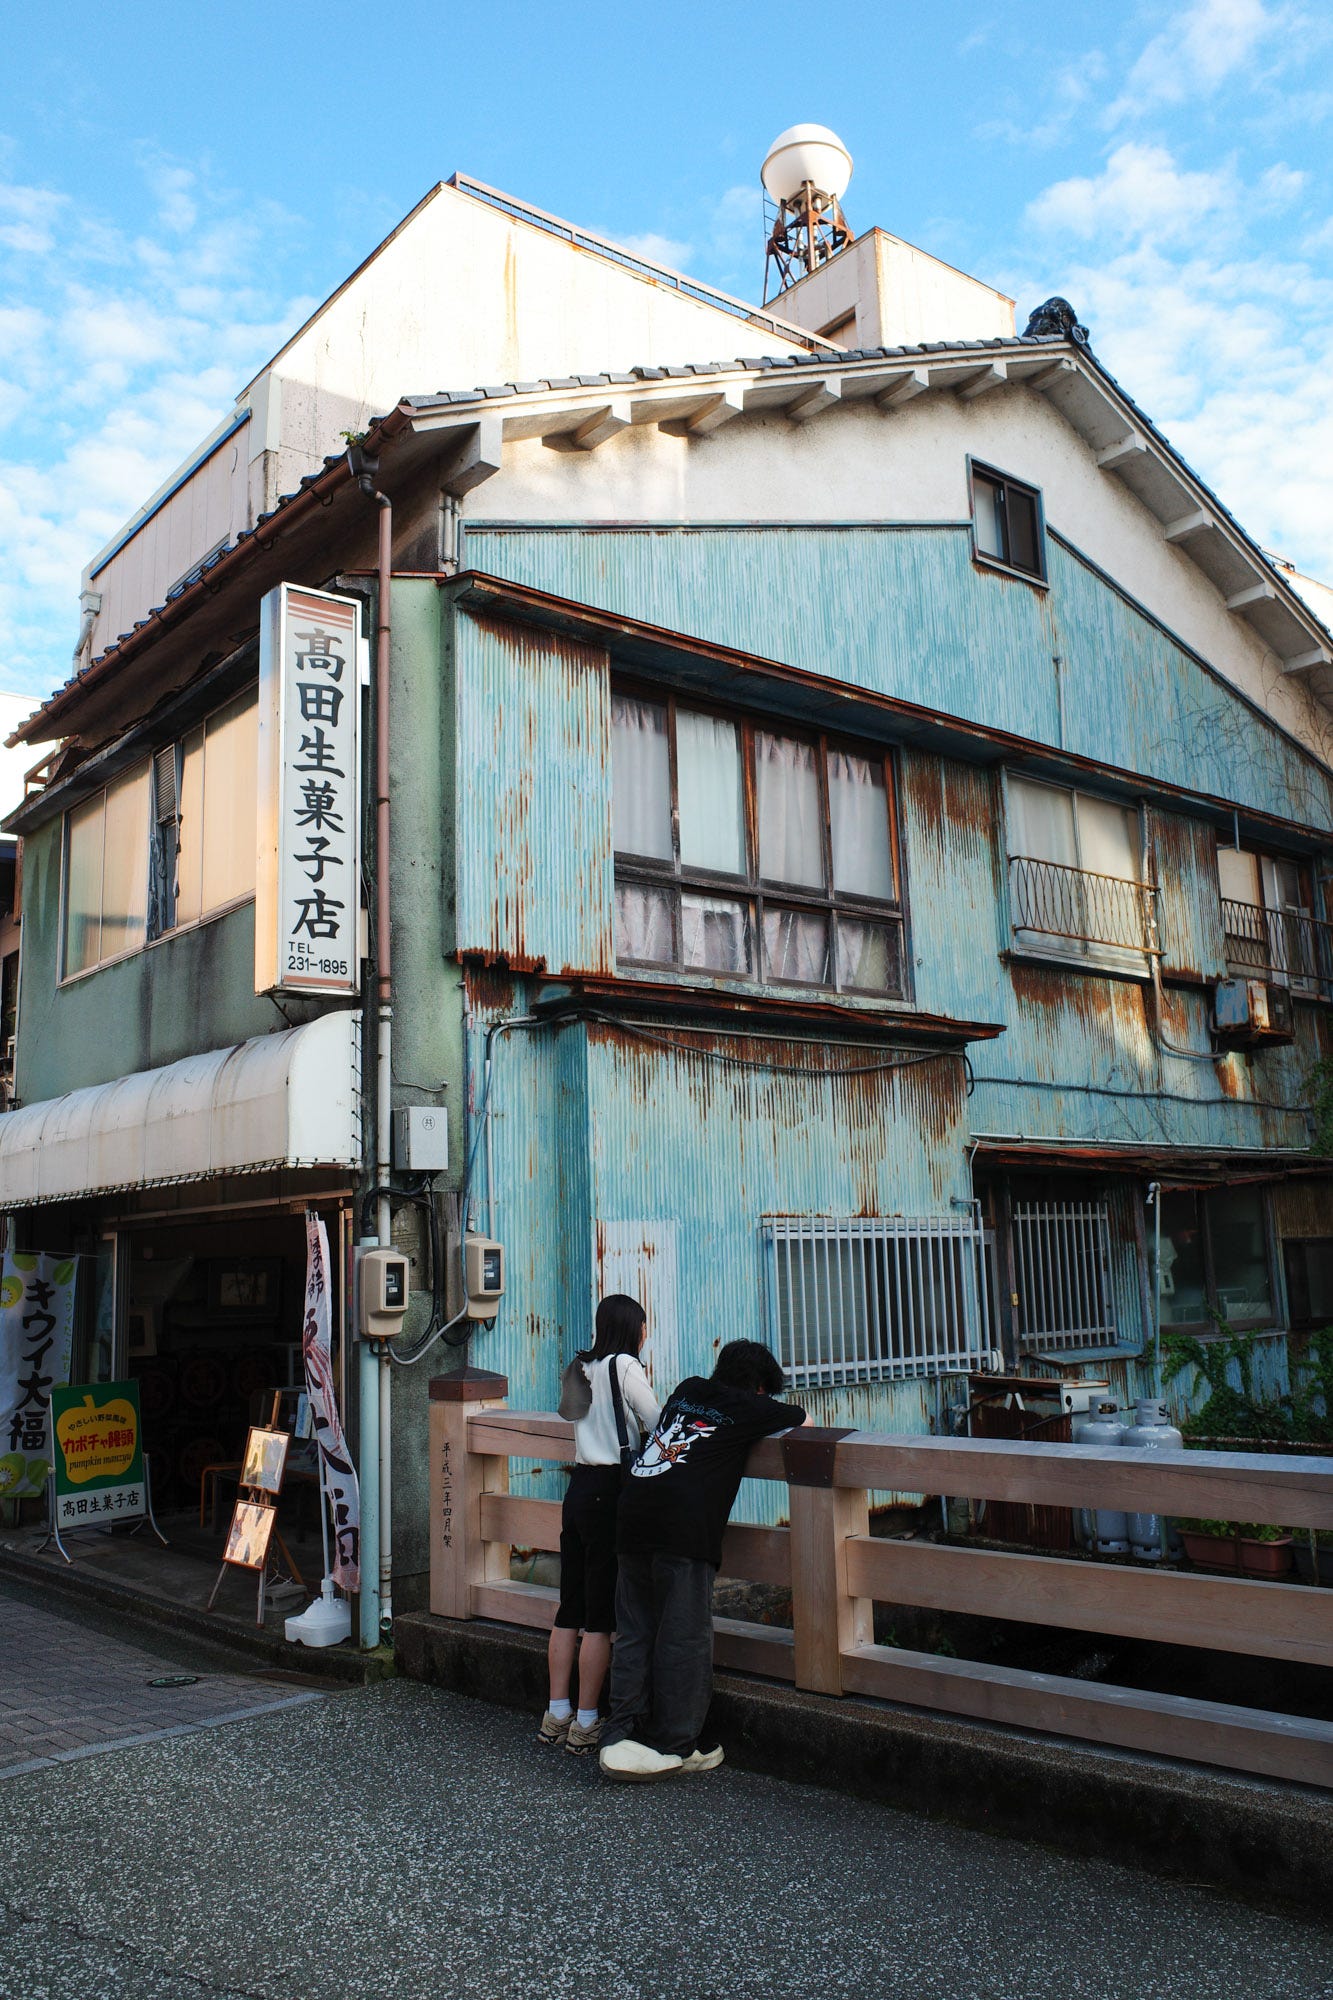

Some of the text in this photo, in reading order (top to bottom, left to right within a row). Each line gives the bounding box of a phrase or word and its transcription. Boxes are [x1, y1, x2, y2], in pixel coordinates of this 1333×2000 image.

[288, 941, 315, 954] TEL
[288, 956, 348, 975] 231-1895
[9, 1278, 56, 1452] キウイ大福
[63, 1429, 134, 1454] カボチャ饅頭
[69, 1455, 102, 1472] pumpkin
